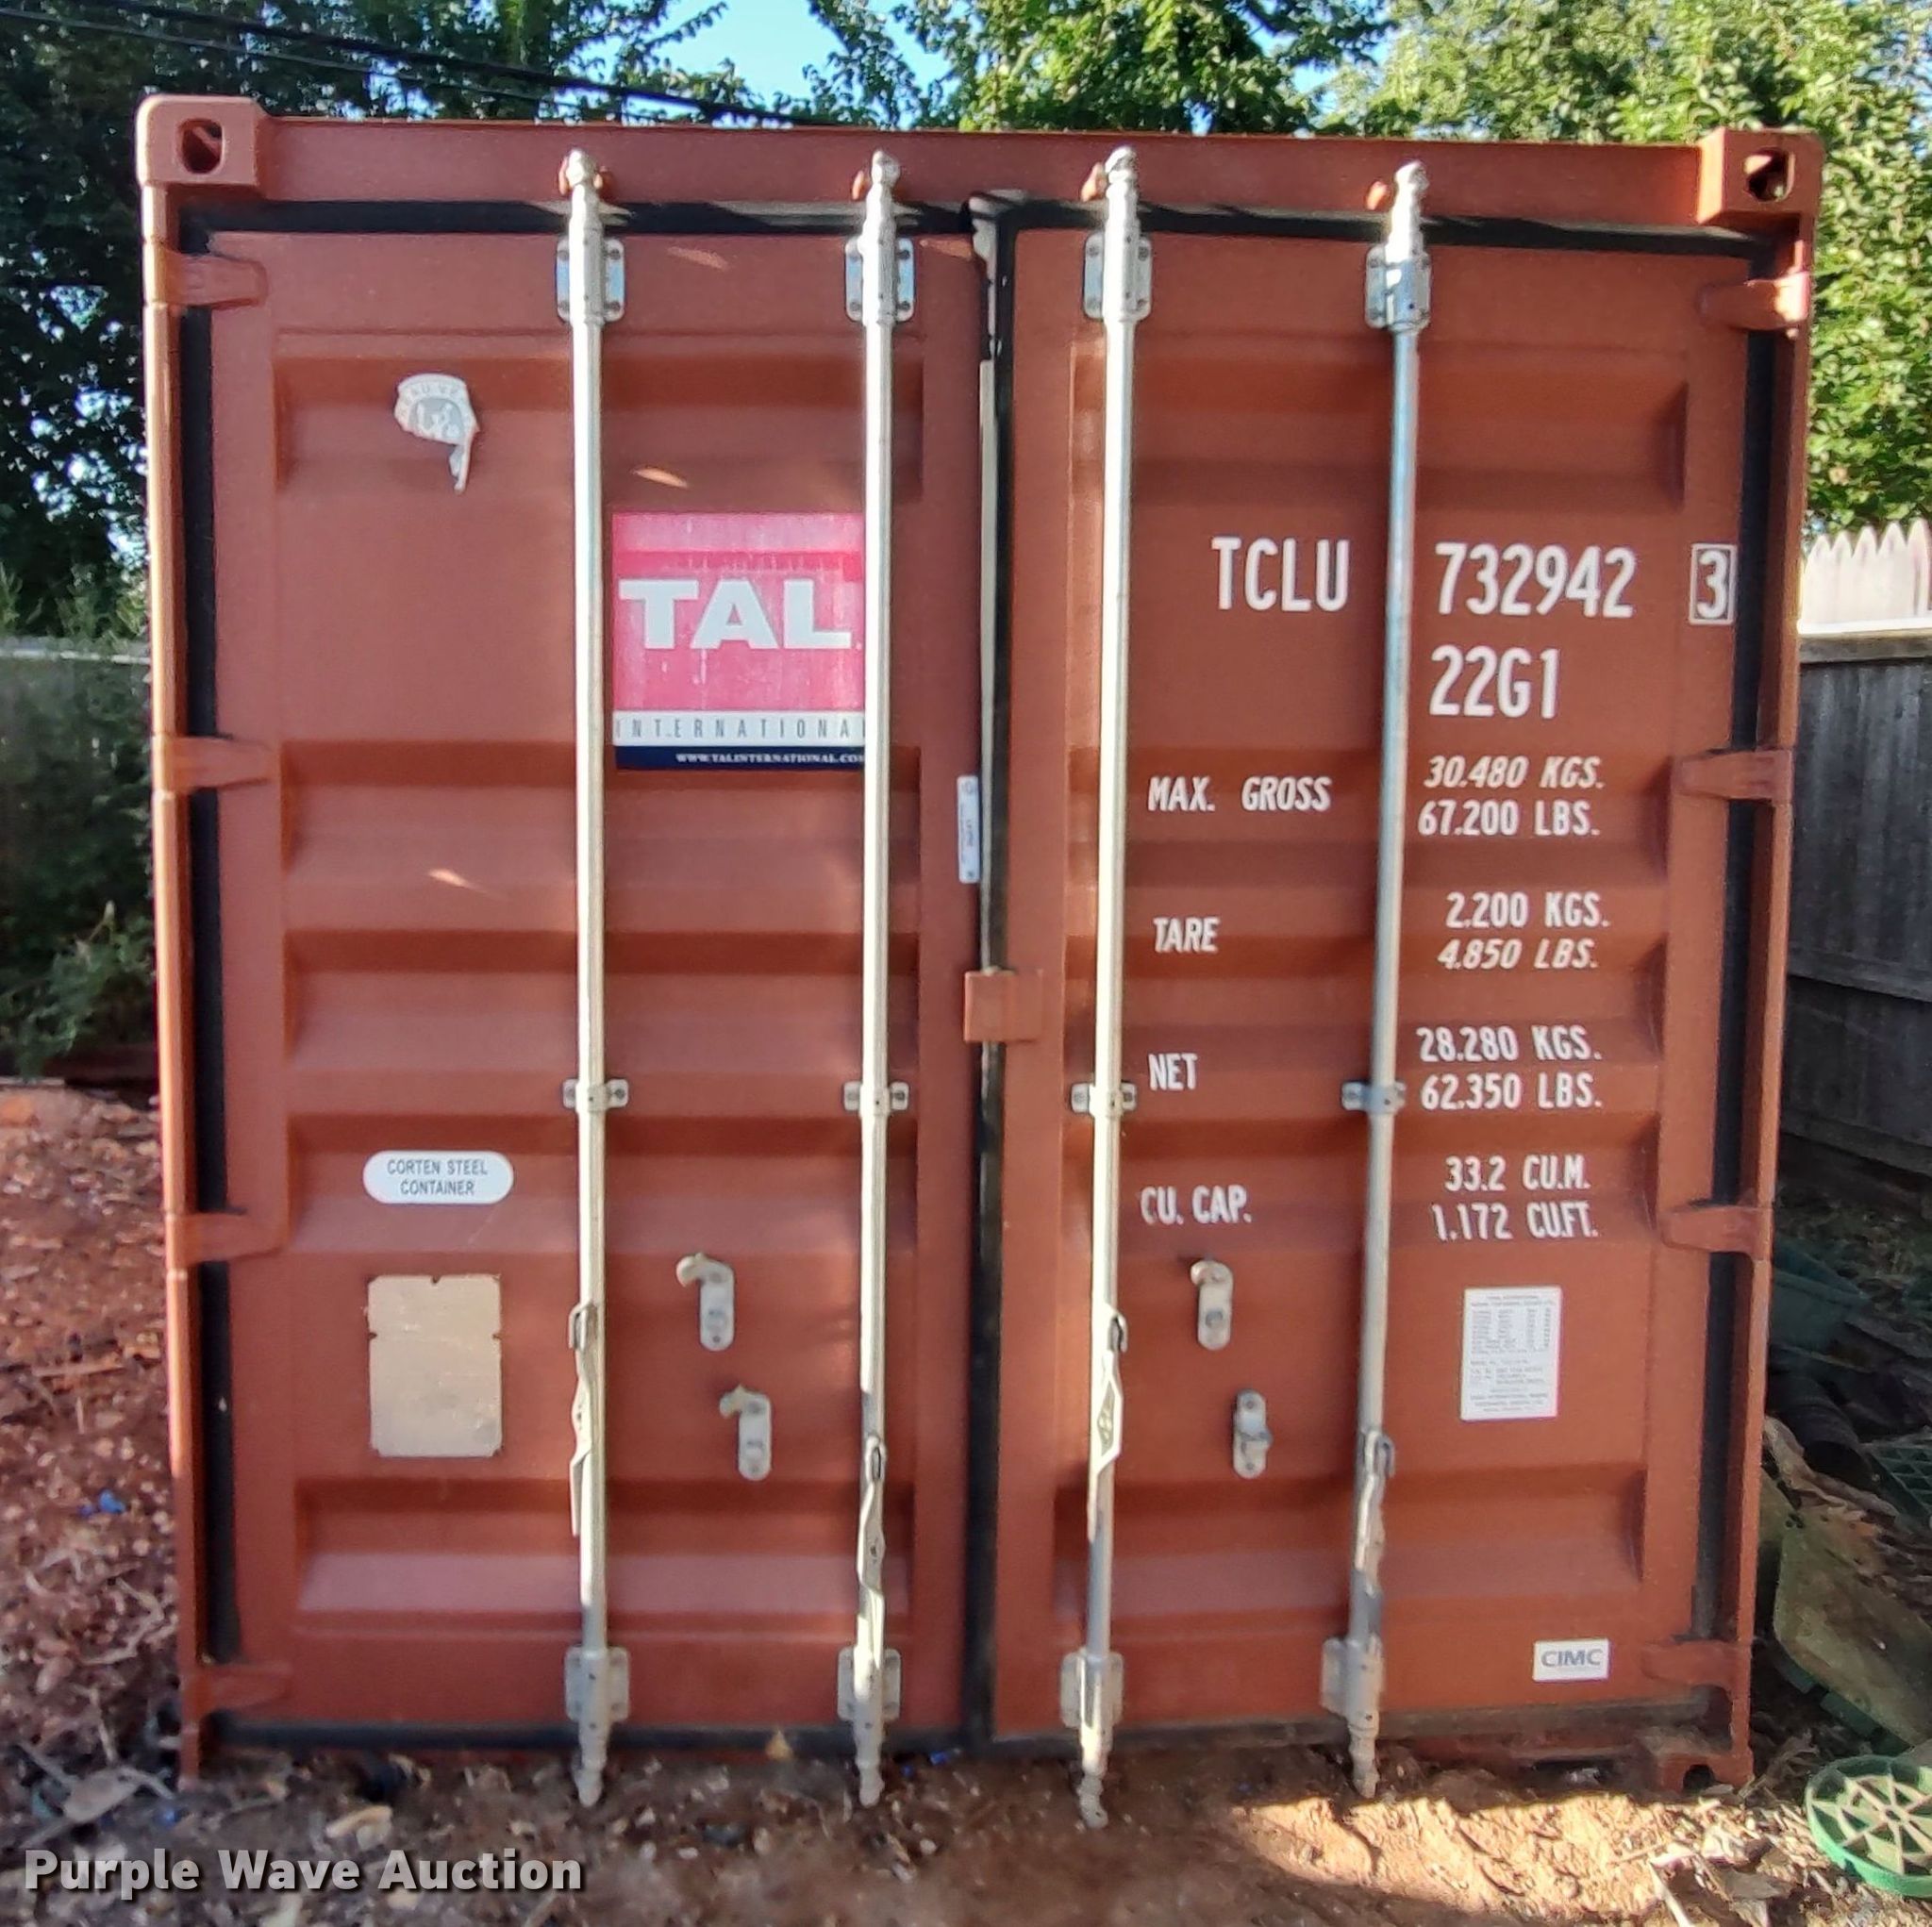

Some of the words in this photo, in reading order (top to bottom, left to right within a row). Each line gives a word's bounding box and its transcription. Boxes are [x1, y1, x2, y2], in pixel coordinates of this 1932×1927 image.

[1211, 536, 1350, 612] TCLU
[1435, 540, 1637, 619] 732942
[1696, 549, 1728, 620] 3
[618, 578, 853, 650] TAL
[1429, 644, 1560, 720] 22G1
[1423, 755, 1526, 789] 30.480
[1539, 756, 1606, 789] KGS.
[1147, 775, 1216, 812] MAX.
[1241, 775, 1332, 813] GROSS
[1417, 799, 1519, 837] 67.200
[1534, 799, 1601, 837] LBS.
[1445, 891, 1529, 929] 2.200
[1543, 891, 1611, 928] KGS.
[1152, 916, 1221, 955] TARE
[1436, 938, 1520, 971] 4.850
[1533, 939, 1600, 970] LBS.
[1415, 1025, 1519, 1063] 28.280
[1530, 1025, 1602, 1061] KGS.
[1147, 1052, 1198, 1091] NET
[1420, 1072, 1521, 1110] 62.350
[1537, 1072, 1603, 1109] LBS.
[387, 1159, 441, 1175] CORTEN
[447, 1159, 489, 1175] STEEL
[1443, 1155, 1507, 1193] 33.2
[400, 1180, 475, 1196] CONTAINER
[1140, 1187, 1184, 1225] CU.
[1191, 1184, 1253, 1224] CAP.
[1431, 1203, 1513, 1242] 1.172
[1541, 1648, 1604, 1668] CIMC
